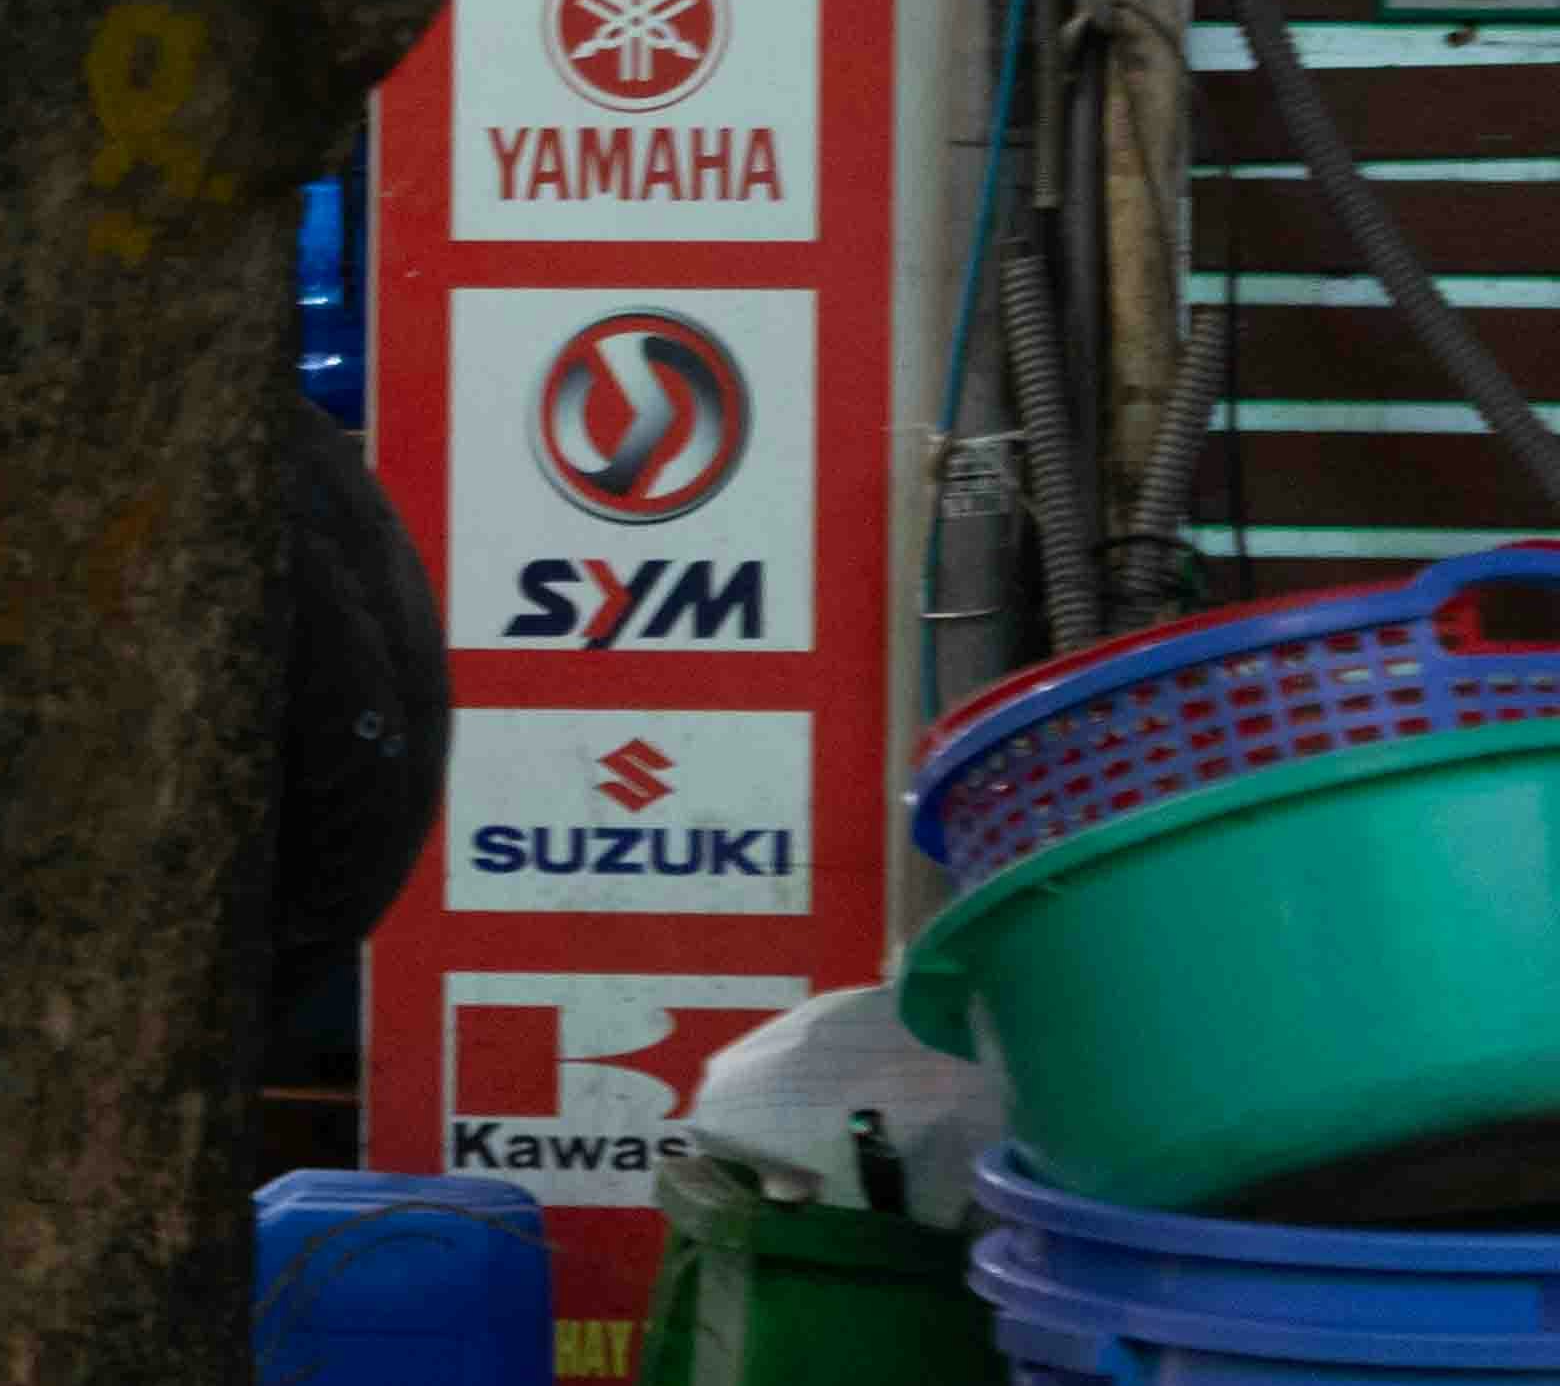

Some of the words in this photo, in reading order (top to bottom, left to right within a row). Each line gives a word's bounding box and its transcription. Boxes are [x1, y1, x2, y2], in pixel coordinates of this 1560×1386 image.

[488, 127, 786, 201] YAMAHA
[503, 558, 764, 650] SYM
[472, 826, 792, 877] SUZUKI
[452, 1122, 689, 1172] Kawas
